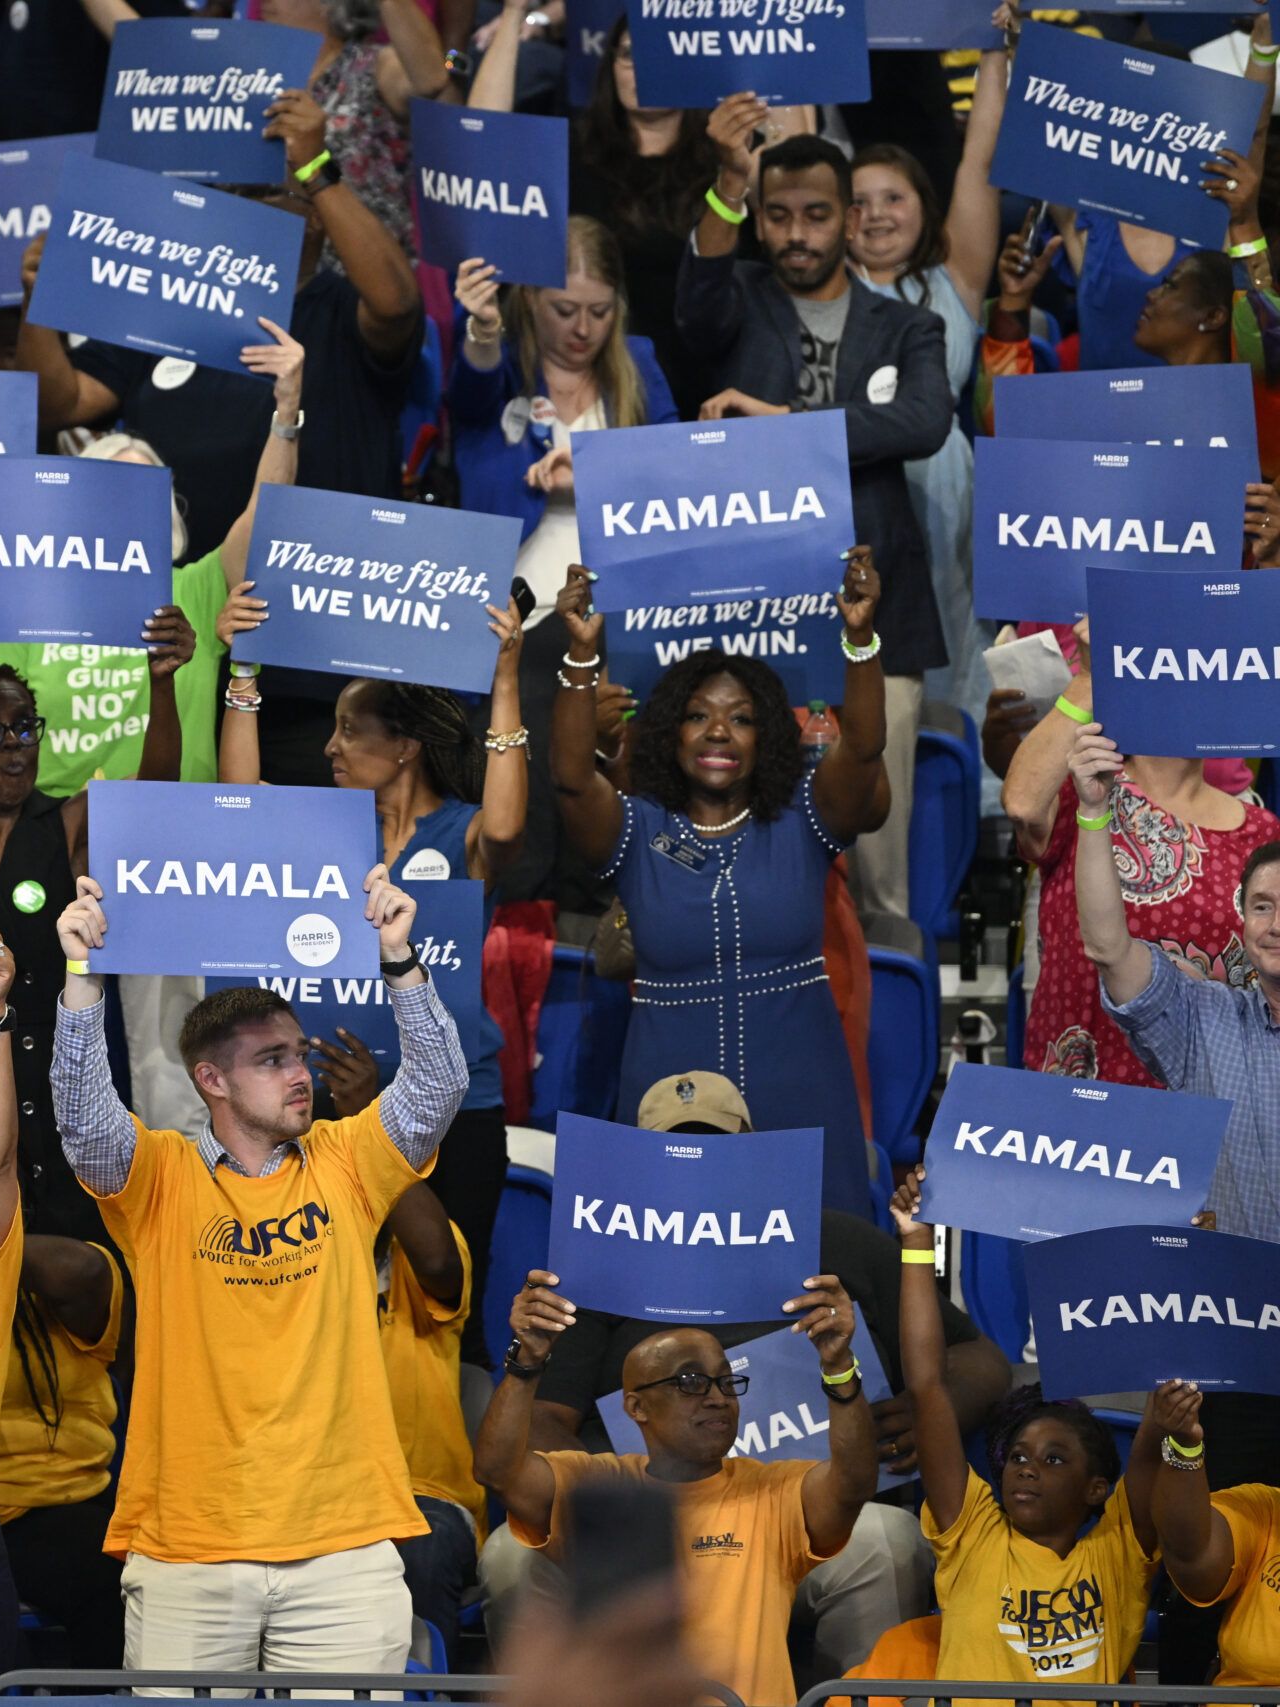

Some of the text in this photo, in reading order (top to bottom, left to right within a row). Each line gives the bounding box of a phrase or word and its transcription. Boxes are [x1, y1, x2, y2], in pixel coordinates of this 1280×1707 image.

[718, 0, 758, 18] we
[668, 28, 816, 56] WE WIN.
[115, 67, 284, 103] When we fight,
[132, 106, 253, 131] WE WIN.
[1024, 76, 1226, 156] When we fight
[1046, 122, 1188, 183] WE WIN.
[423, 169, 548, 217] KAMALA
[68, 211, 278, 293] When we fight,
[92, 257, 243, 317] WE WIN.
[691, 431, 726, 439] HARRIS
[372, 510, 406, 520] HARRIS
[603, 487, 825, 536] KAMALA
[999, 513, 1215, 554] KAMALA
[267, 540, 491, 603] When we fight,
[291, 585, 450, 632] WE WIN.
[624, 605, 708, 631] When
[714, 601, 754, 623] we
[721, 630, 807, 657] WIN.
[1114, 646, 1280, 680] KAMA
[118, 860, 349, 899] KAMALA
[409, 864, 445, 874] HARRIS
[292, 932, 334, 942] HARRIS
[414, 936, 461, 971] ht,
[258, 977, 392, 1005] WE WI
[1073, 1088, 1108, 1097] HARRIS
[666, 1146, 702, 1154] HARRIS
[954, 1123, 1180, 1189] KAMALA
[233, 1202, 330, 1258] UFCW
[573, 1195, 794, 1245] KAMALA
[1152, 1236, 1188, 1244] HARRIS
[199, 1249, 234, 1265] VOICE
[239, 1255, 257, 1267] for
[224, 1264, 319, 1286] www.ufcw.or
[728, 1403, 831, 1458] MAL
[1001, 1602, 1019, 1623] fo
[1020, 1609, 1105, 1648] BAM
[1030, 1652, 1074, 1672] 2012
